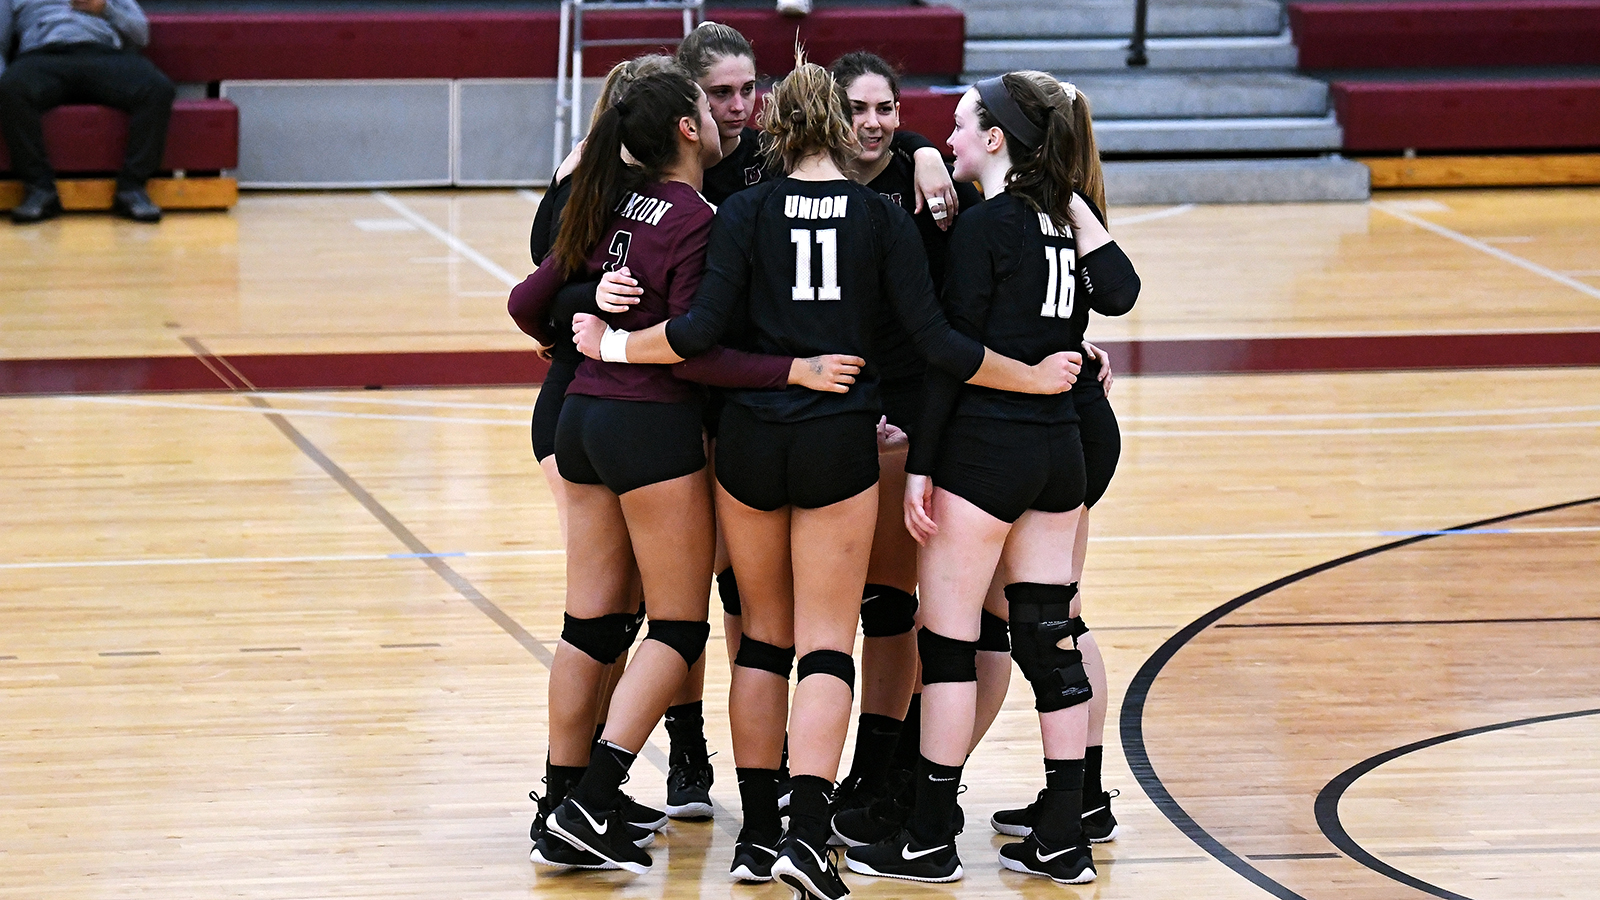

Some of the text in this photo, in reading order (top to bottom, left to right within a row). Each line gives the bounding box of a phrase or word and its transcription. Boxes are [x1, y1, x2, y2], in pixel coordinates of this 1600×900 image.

[613, 190, 674, 227] NION
[784, 195, 848, 220] UNION
[790, 228, 842, 301] 11
[1040, 245, 1076, 319] 16
